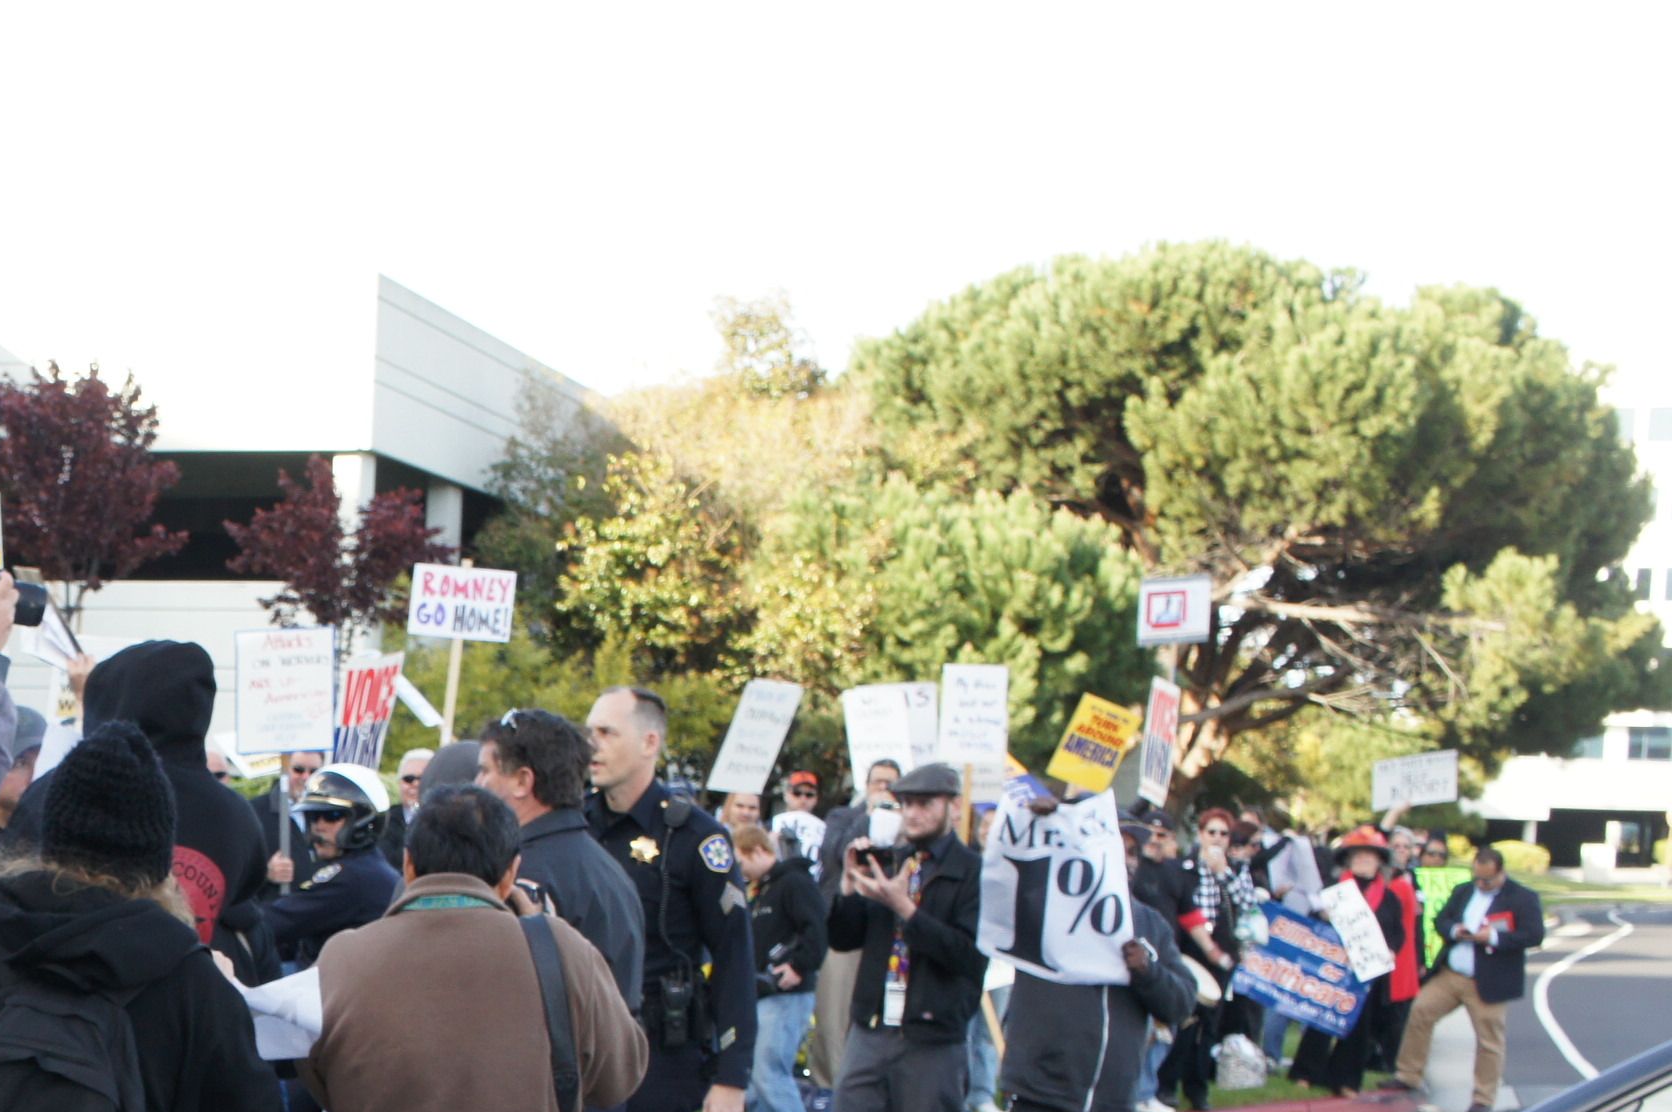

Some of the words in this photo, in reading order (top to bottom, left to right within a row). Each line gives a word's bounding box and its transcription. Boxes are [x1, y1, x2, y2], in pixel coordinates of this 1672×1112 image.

[422, 571, 510, 604] ROMNEY
[416, 602, 446, 626] GO
[452, 603, 509, 637] HOME!
[1063, 733, 1120, 768] AMERICA
[999, 814, 1065, 849] Mr.
[994, 851, 1124, 973] 1%
[1243, 950, 1357, 1015] ealthcare
